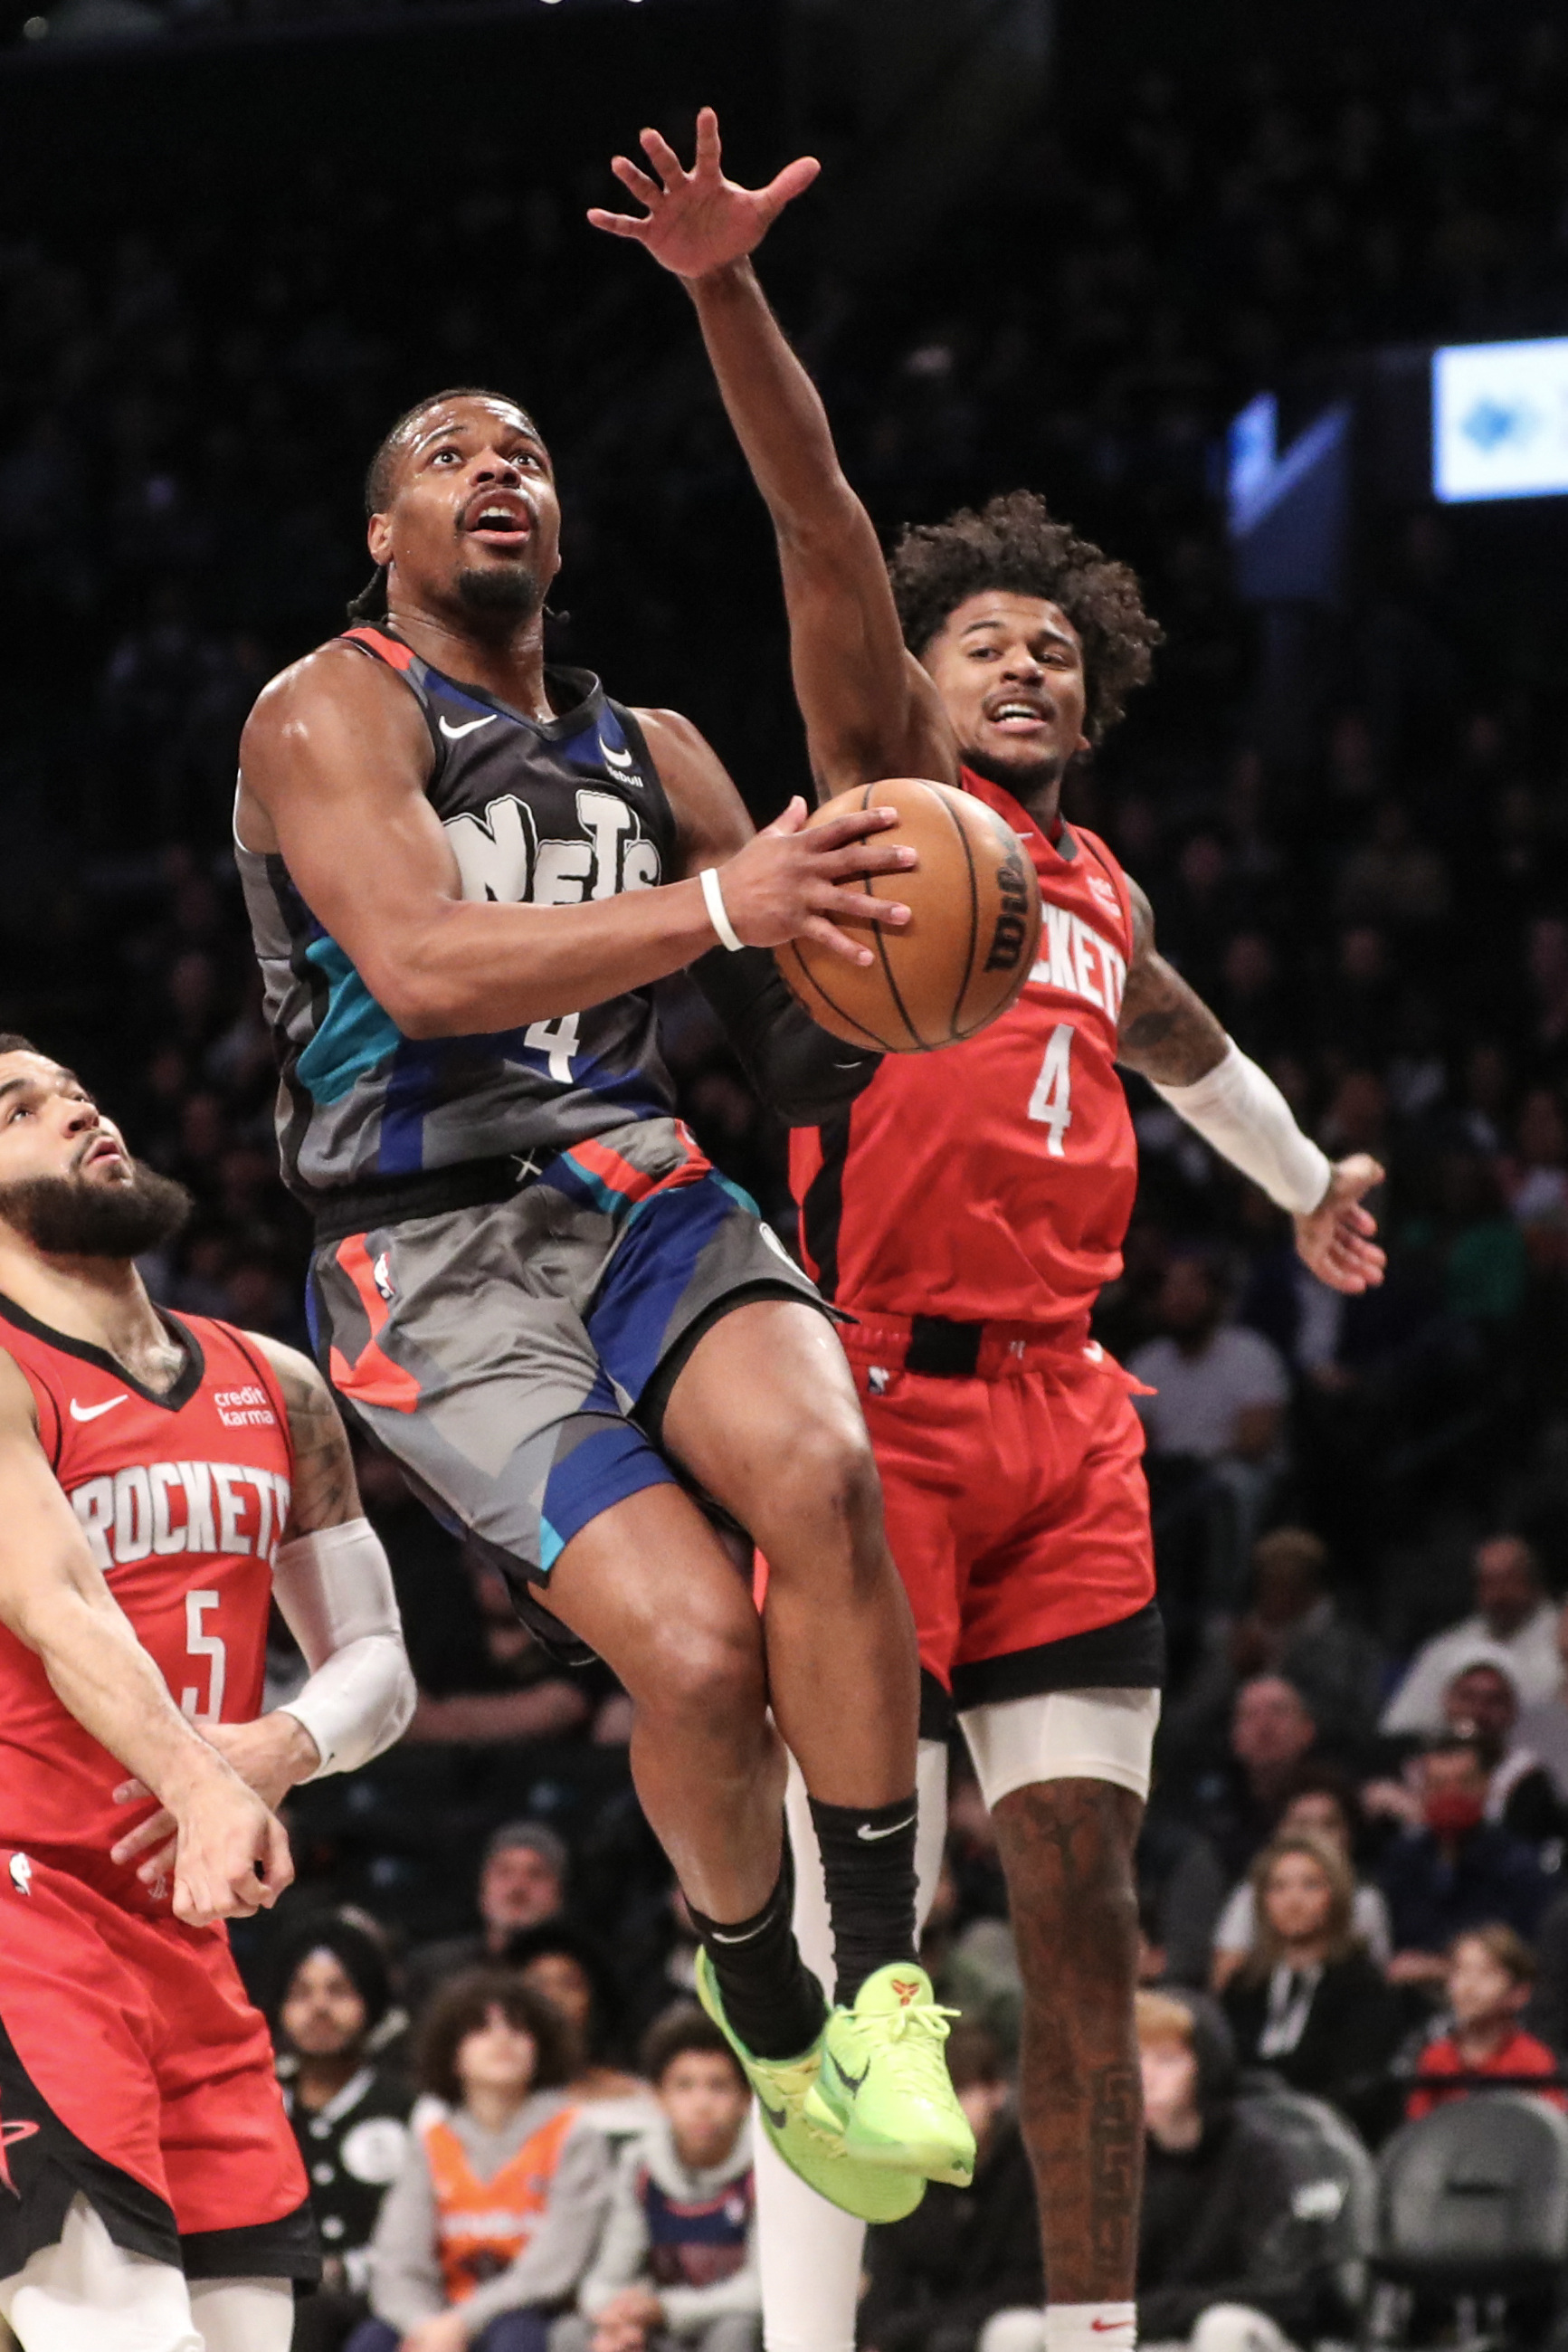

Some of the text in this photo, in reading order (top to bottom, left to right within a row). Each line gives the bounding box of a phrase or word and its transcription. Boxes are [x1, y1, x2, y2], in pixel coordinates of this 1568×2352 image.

[523, 1011, 581, 1085] 4
[1028, 1023, 1075, 1158] 4
[214, 1385, 267, 1407] credit
[217, 1407, 276, 1427] karma
[181, 1589, 225, 1725] 5
